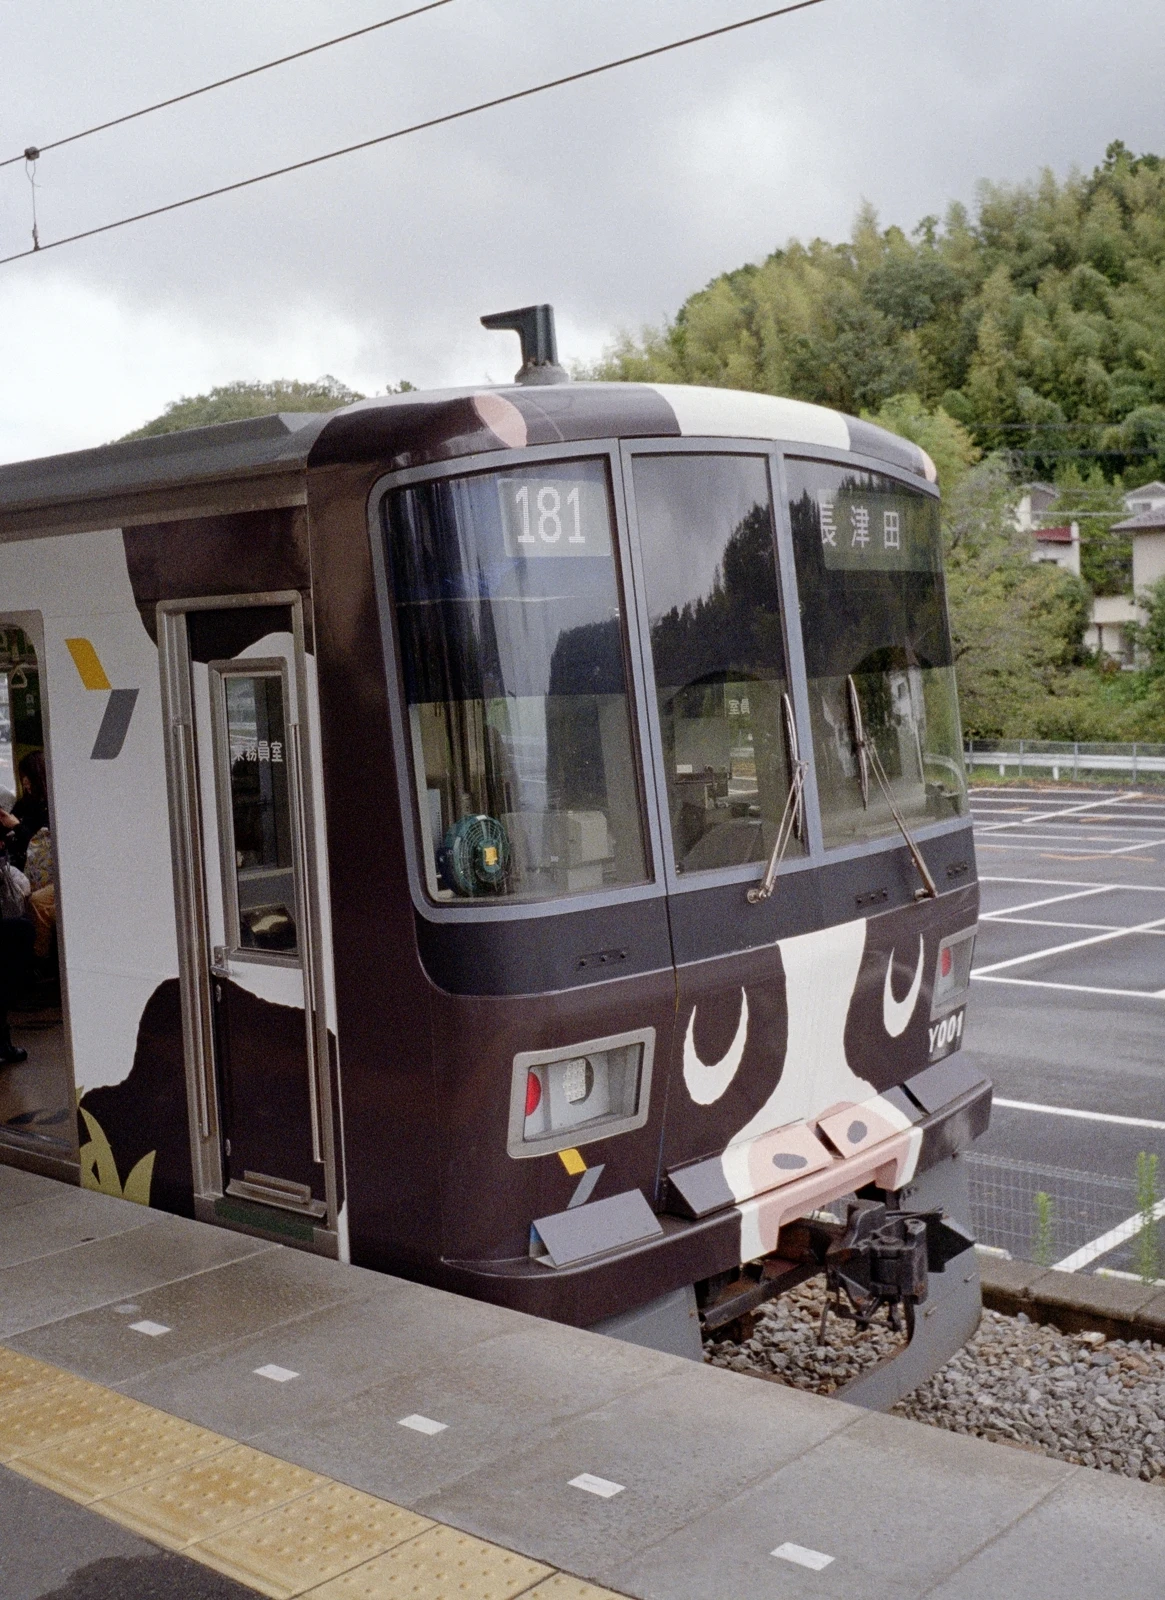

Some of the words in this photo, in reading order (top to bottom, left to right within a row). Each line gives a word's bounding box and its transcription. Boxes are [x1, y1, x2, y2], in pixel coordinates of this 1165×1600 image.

[515, 486, 586, 543] 181
[820, 504, 900, 550] 長津田
[928, 1010, 964, 1053] Y001
